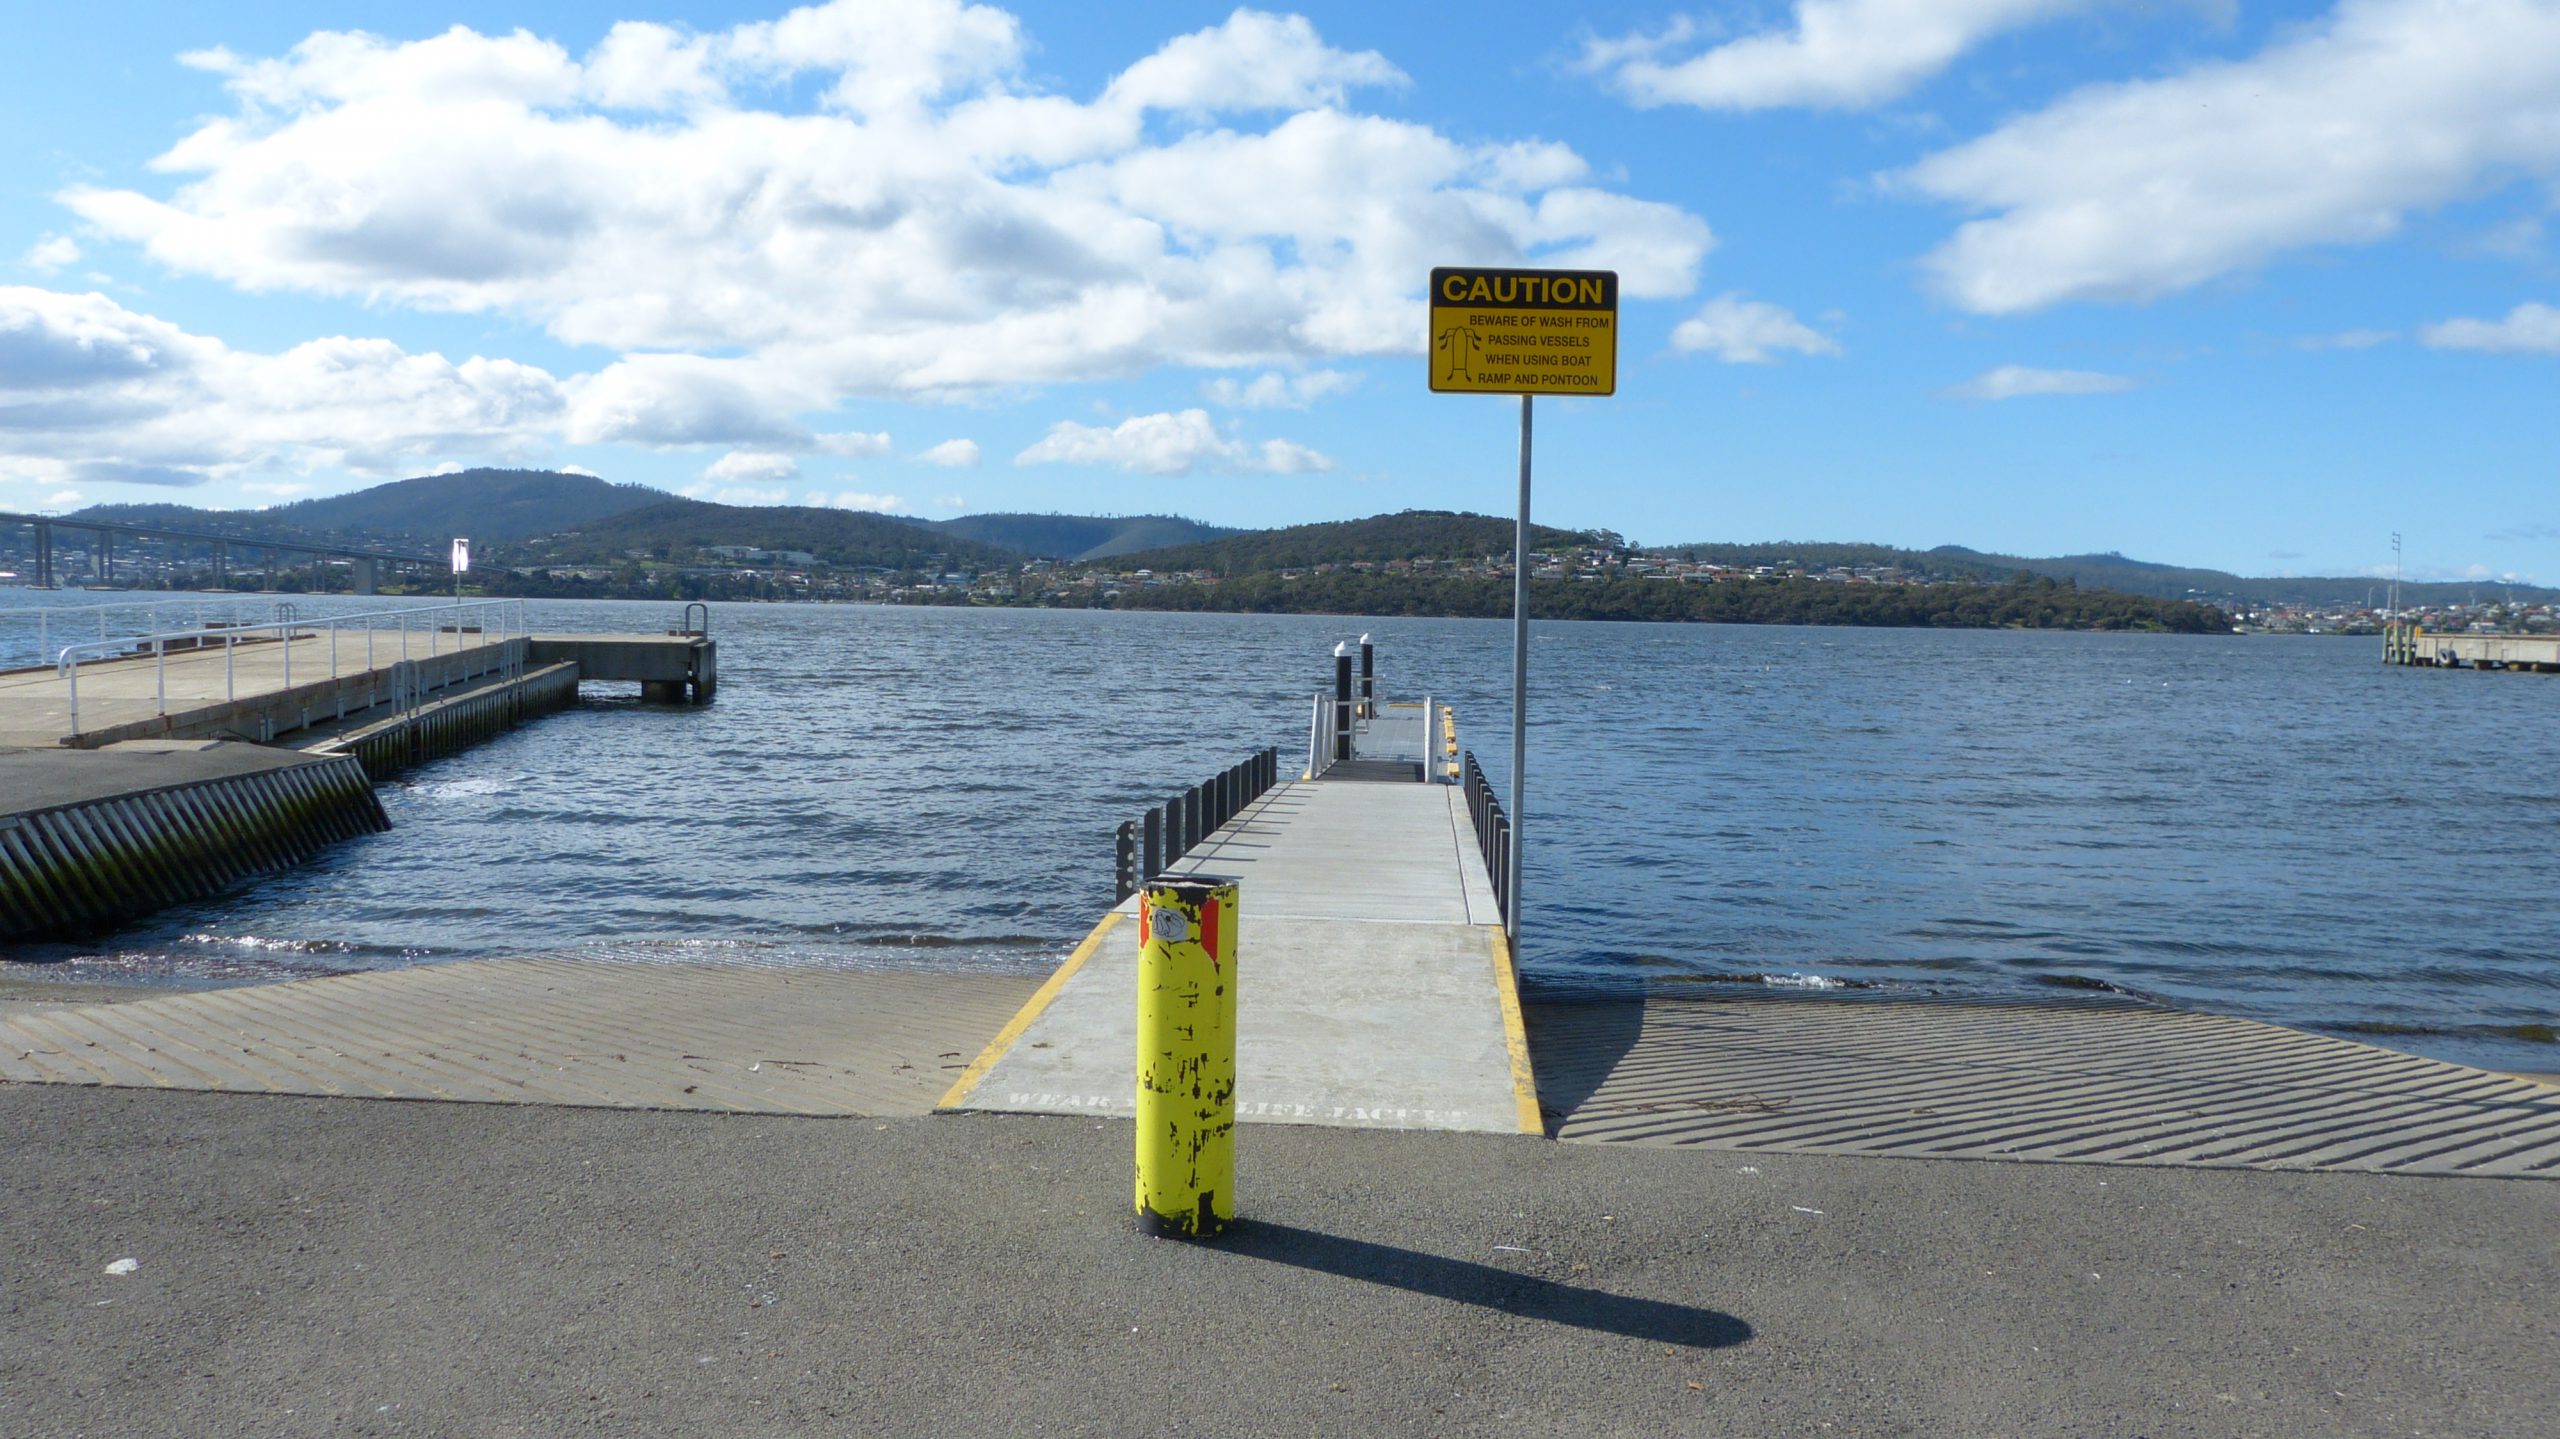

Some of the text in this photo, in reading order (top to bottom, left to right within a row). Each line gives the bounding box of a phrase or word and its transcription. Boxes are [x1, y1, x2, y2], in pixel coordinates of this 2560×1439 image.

[1442, 274, 1603, 305] CAUTION
[1469, 314, 1609, 329] BEWARE OF WASH FROM
[1488, 334, 1590, 347] PASSING VESSELS
[1485, 354, 1592, 367] WHEN USING BOAT
[1478, 373, 1598, 386] RAMP AND PONTOON
[1234, 1101, 1315, 1118] LIFE
